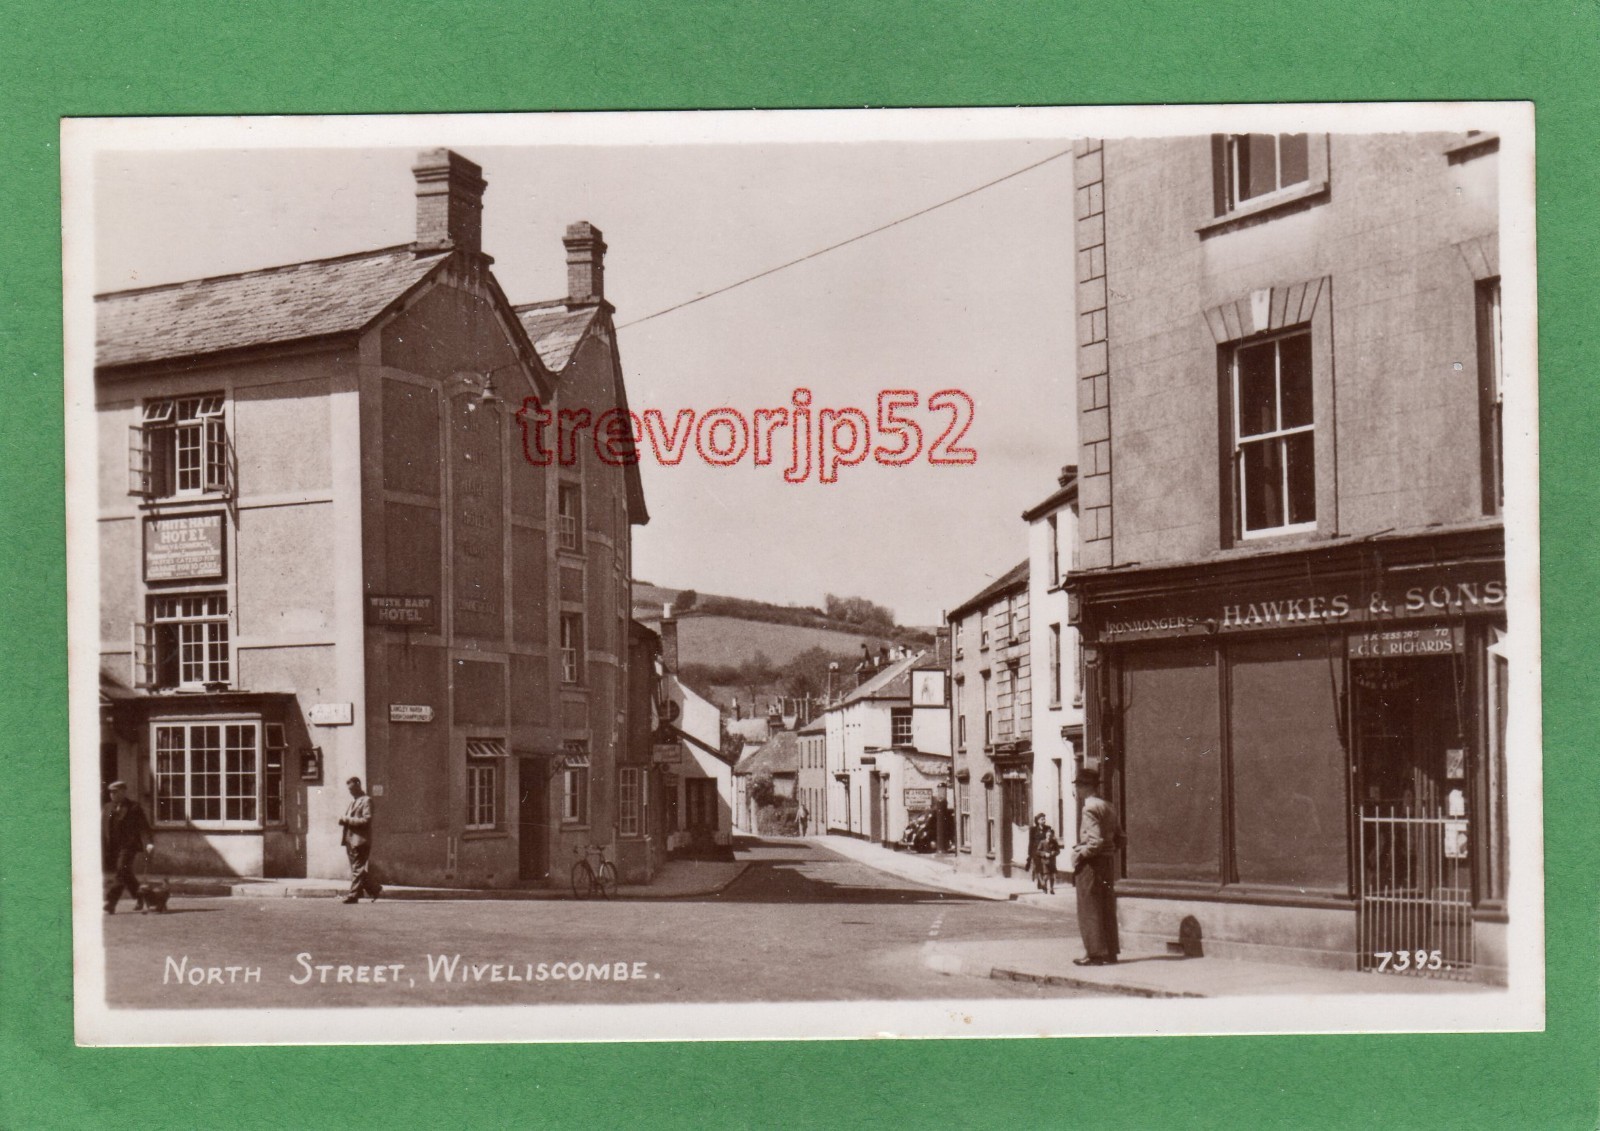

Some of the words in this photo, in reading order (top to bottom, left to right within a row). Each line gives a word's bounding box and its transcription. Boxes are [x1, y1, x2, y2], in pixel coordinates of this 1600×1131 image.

[149, 519, 187, 531] WHITE
[189, 517, 218, 528] HART
[161, 528, 207, 544] HOTEL
[370, 597, 401, 607] WHITE
[404, 598, 431, 608] HART
[1222, 594, 1350, 627] HAWKES
[1369, 591, 1390, 613] &
[1405, 581, 1505, 610] SONS
[379, 608, 422, 621] HOTEL
[1106, 615, 1195, 634] IRONMONGERS
[1434, 628, 1449, 637] TO
[1390, 640, 1453, 654] RICHARDS
